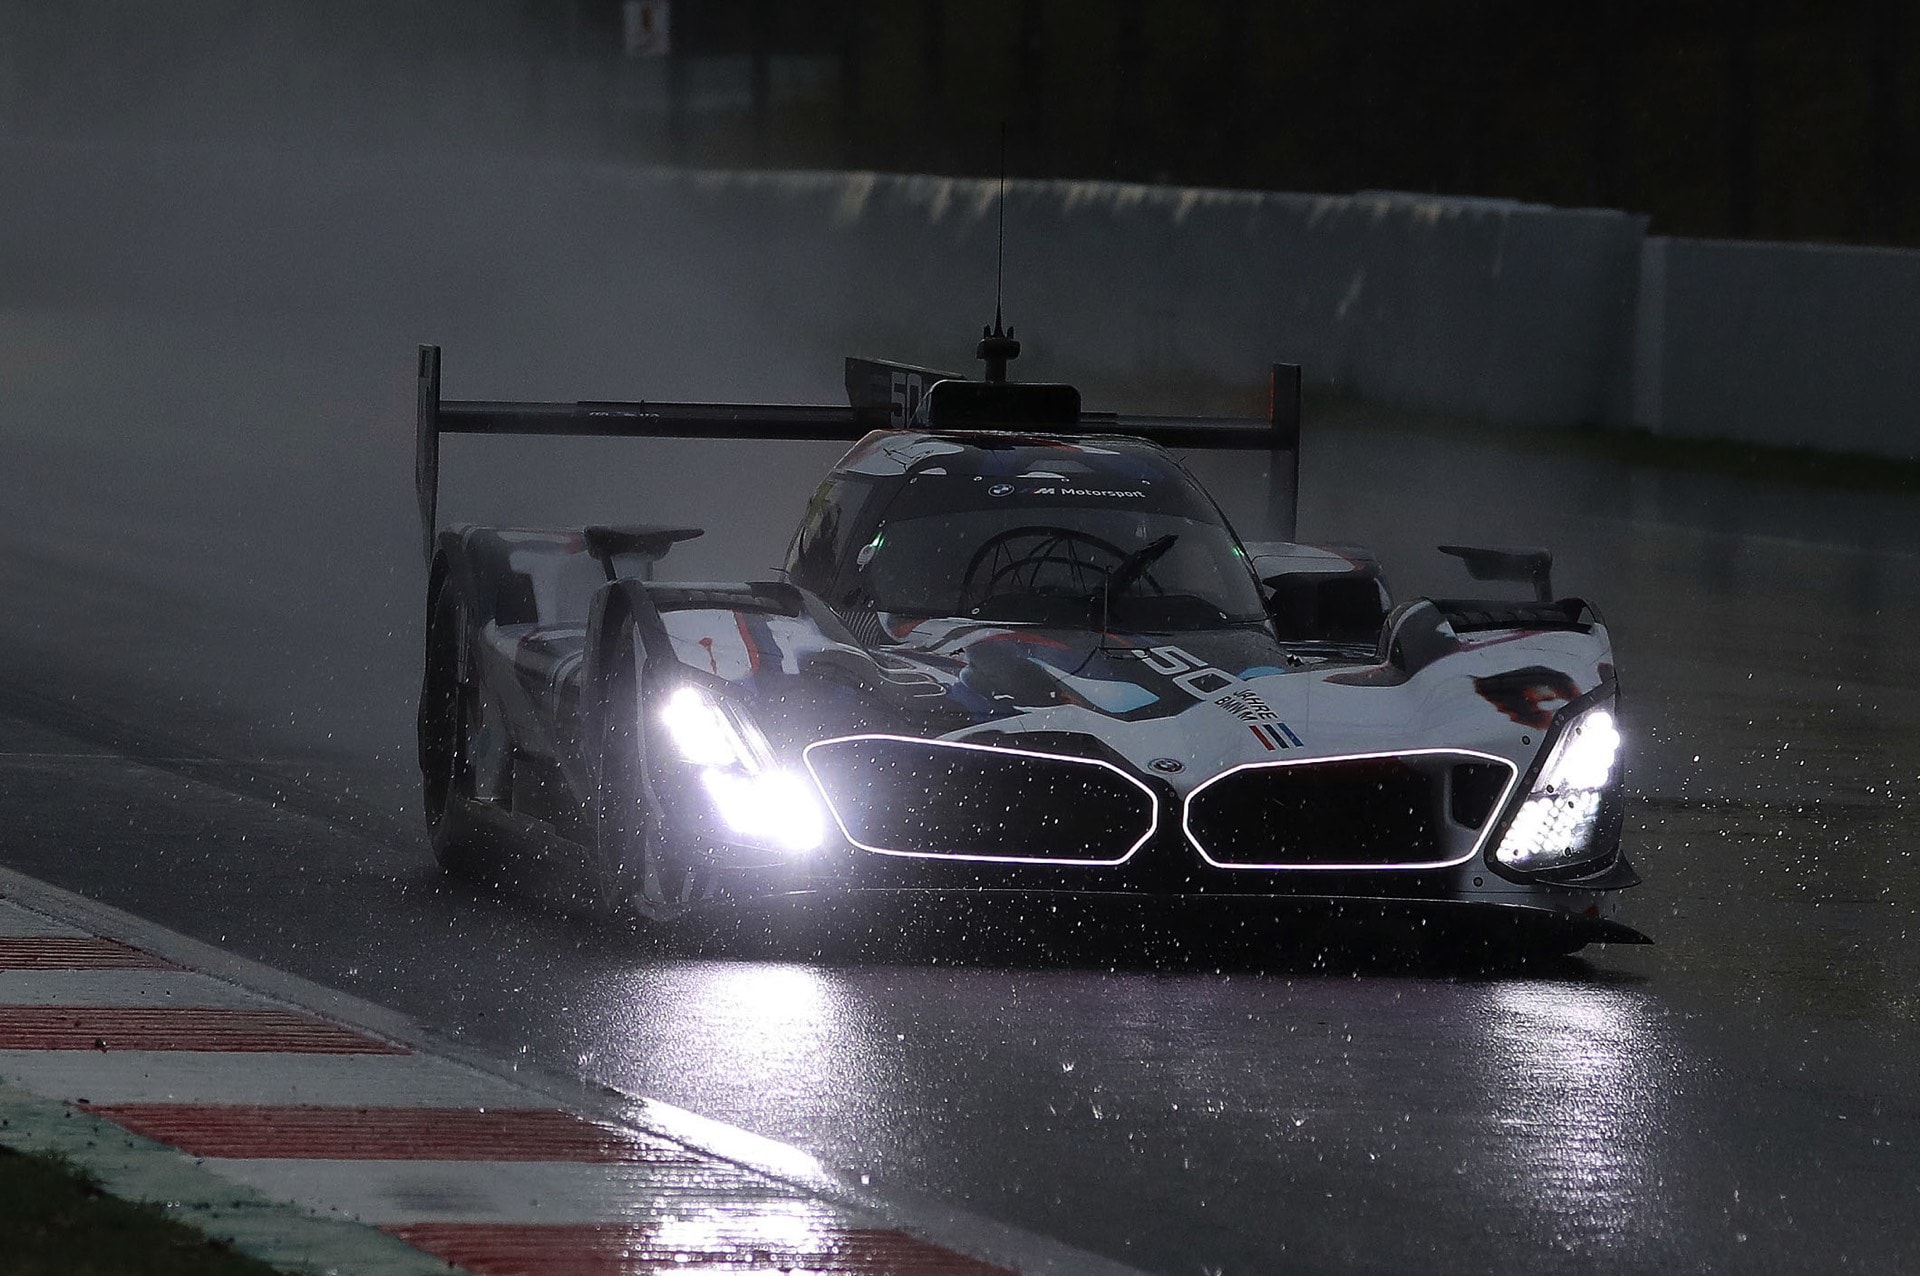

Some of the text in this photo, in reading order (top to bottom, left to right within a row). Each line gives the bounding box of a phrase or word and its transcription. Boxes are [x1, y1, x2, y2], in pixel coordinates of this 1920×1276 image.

[1061, 488, 1146, 498] Motorsport
[1131, 645, 1242, 701] 50
[1234, 689, 1278, 720] JAHRE
